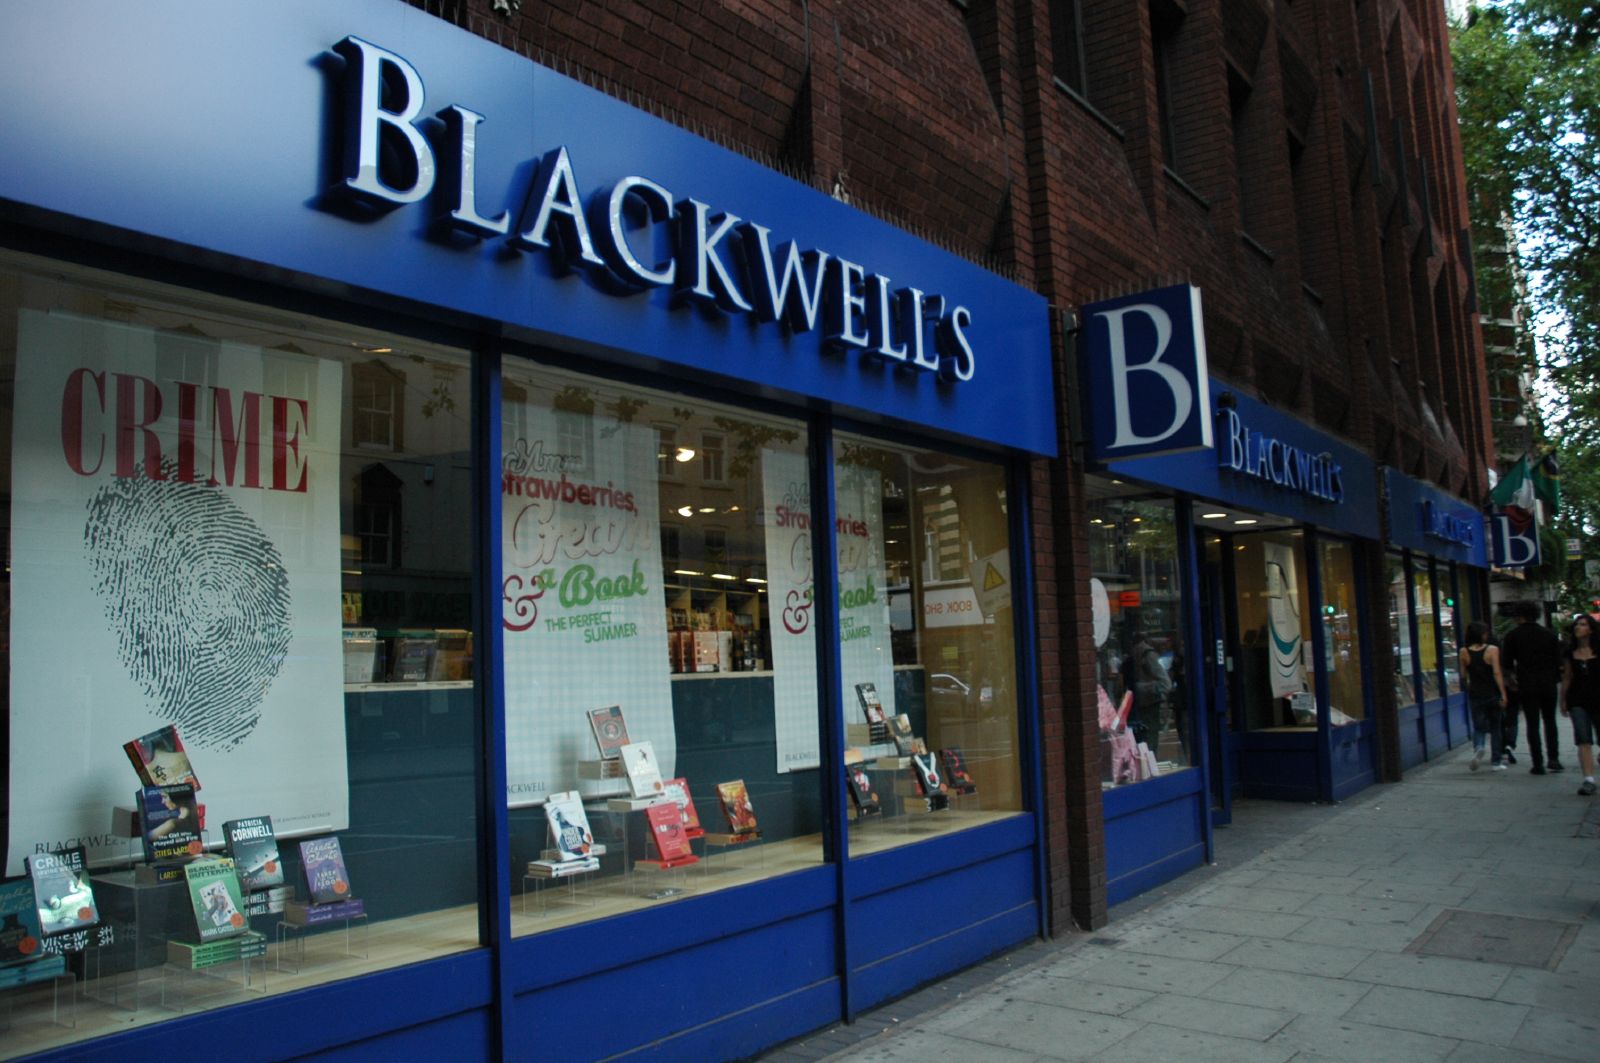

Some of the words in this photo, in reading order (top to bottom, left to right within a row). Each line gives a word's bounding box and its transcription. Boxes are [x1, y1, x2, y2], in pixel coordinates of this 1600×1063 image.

[343, 36, 976, 383] BLACKWELL'S
[1092, 303, 1193, 449] B
[61, 367, 309, 493] CRIME
[502, 575, 546, 632] &
[558, 558, 648, 608] Book
[839, 575, 878, 610] ook
[545, 618, 565, 632] THE
[569, 611, 612, 629] PERFECT
[584, 622, 638, 644] SUMMER
[506, 781, 545, 794] ACKWELL
[35, 834, 118, 853] BLACKWE
[232, 824, 272, 842] CORNWELL
[35, 852, 81, 870] CRIME
[189, 868, 234, 880] BUTTERFLY
